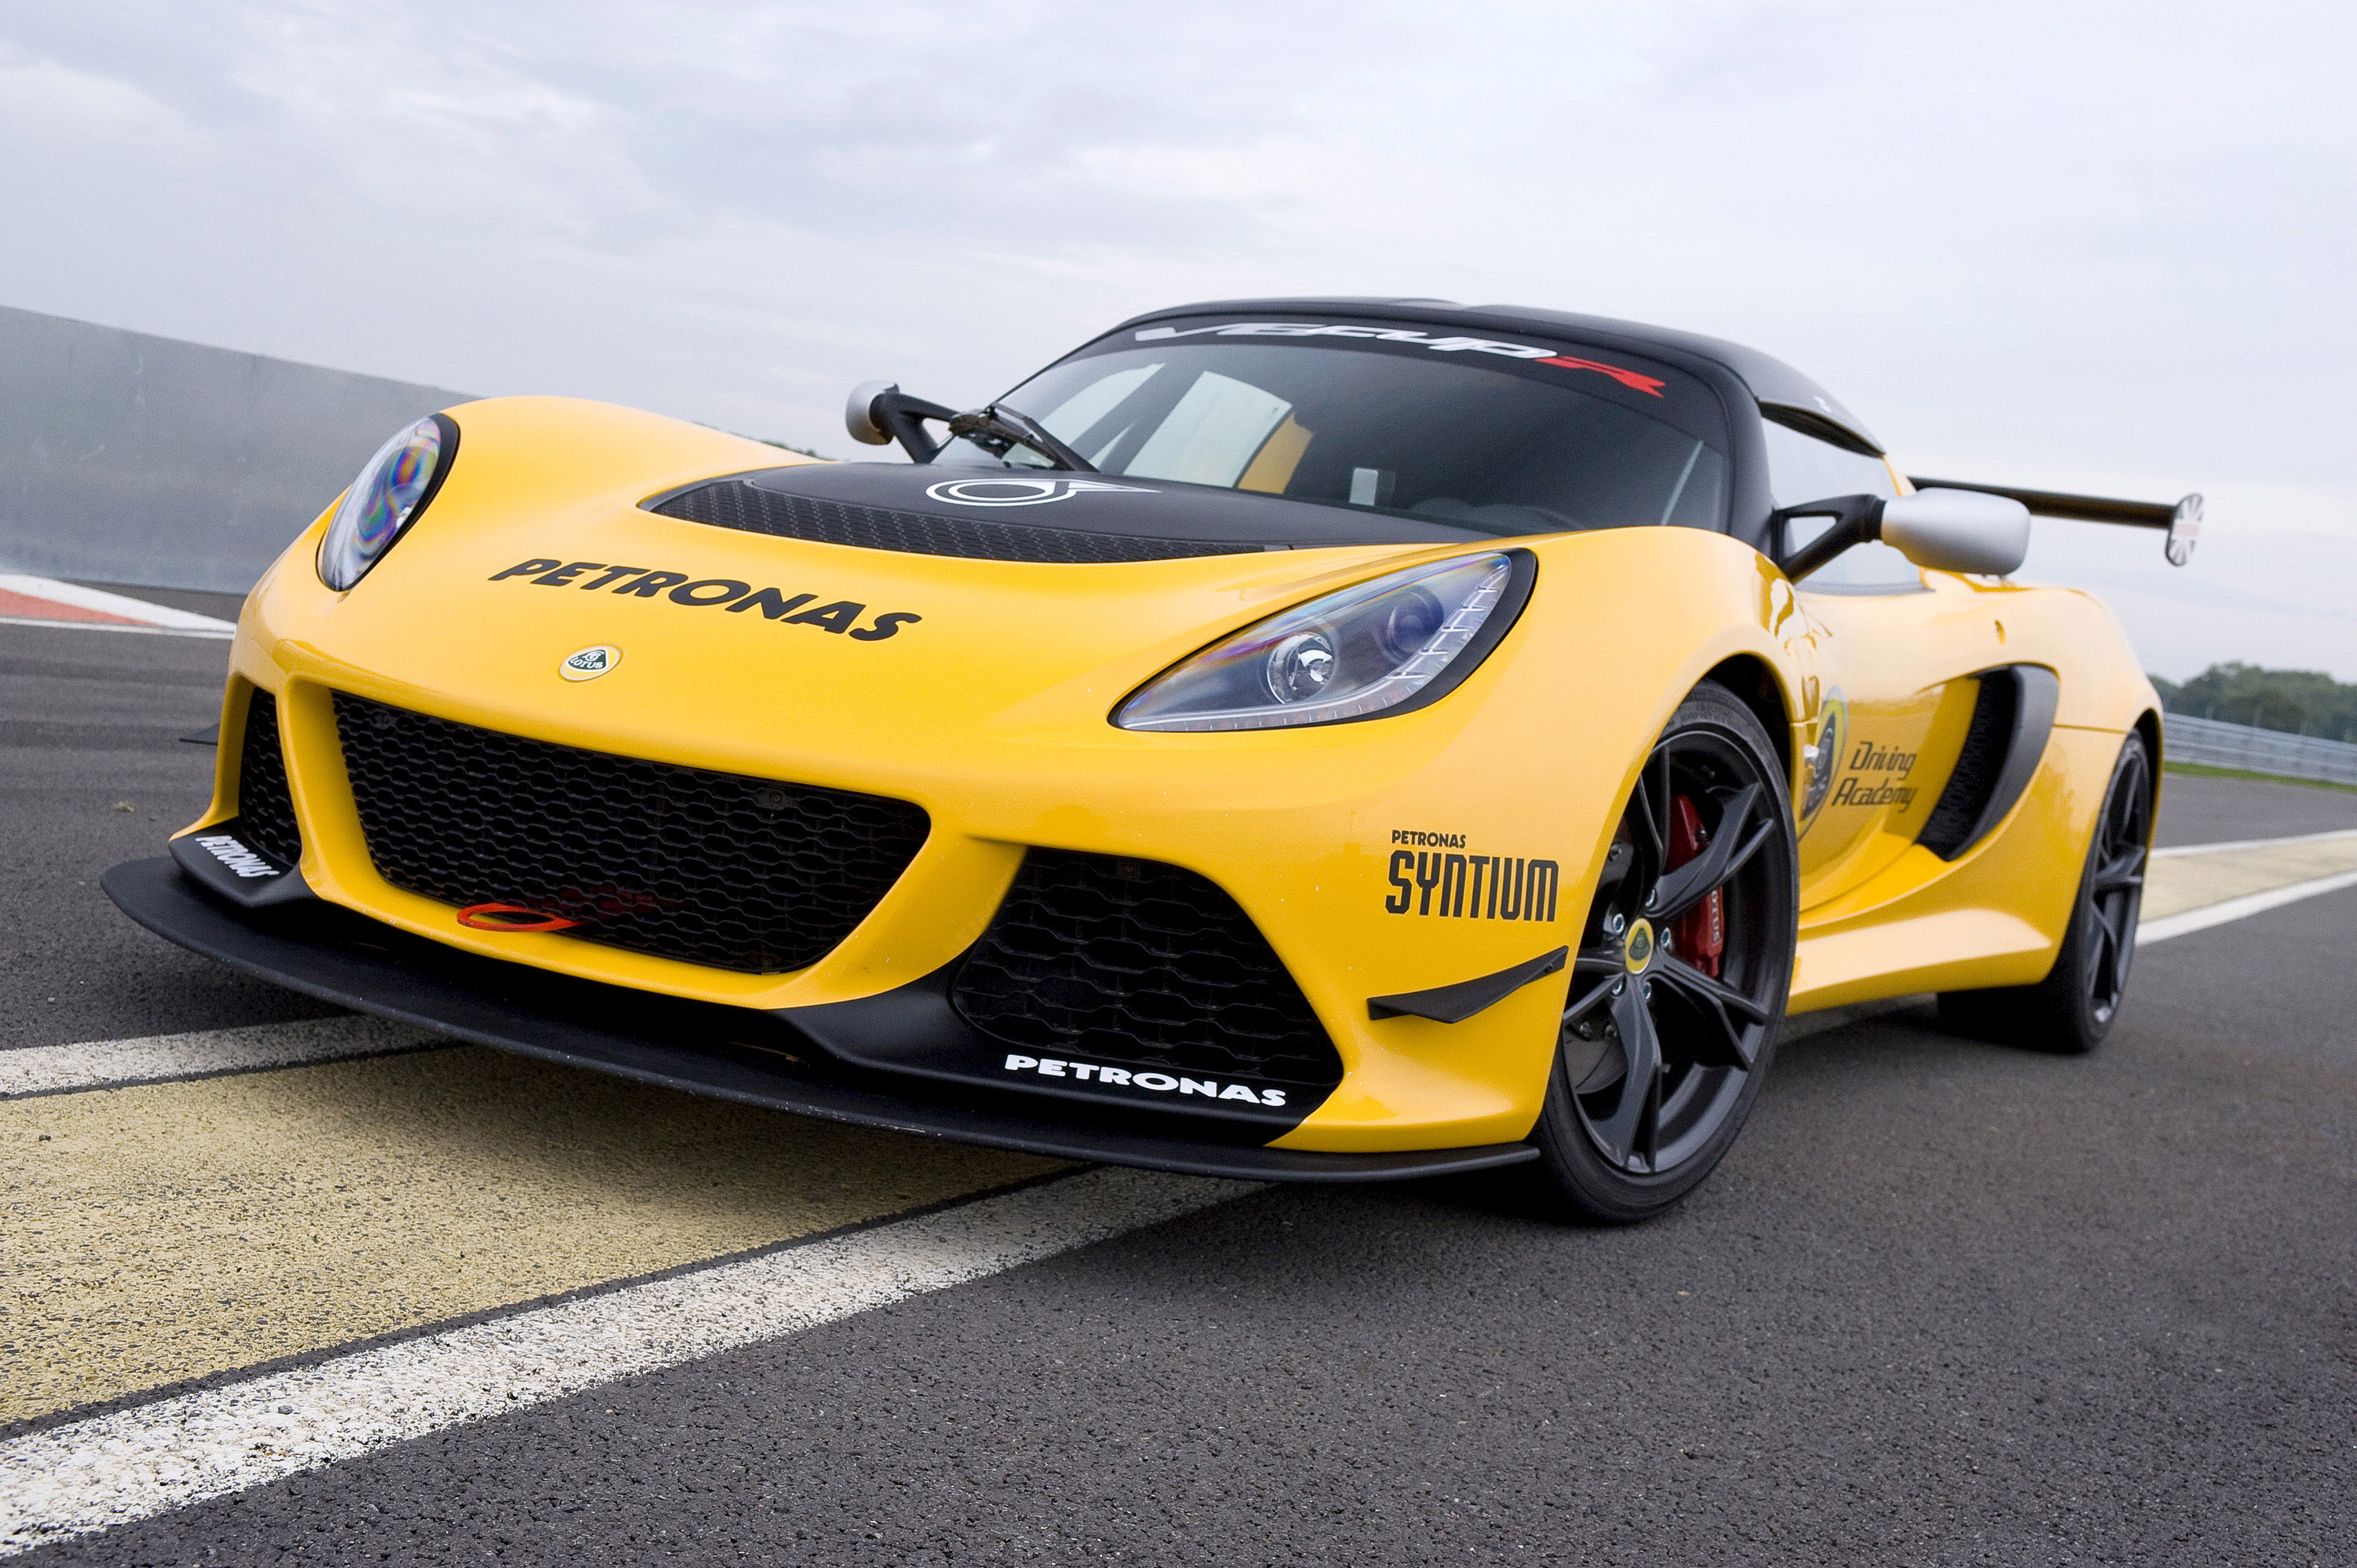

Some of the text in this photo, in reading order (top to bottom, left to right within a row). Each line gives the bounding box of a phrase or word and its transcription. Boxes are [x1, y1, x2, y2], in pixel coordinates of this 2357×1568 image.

[488, 559, 922, 641] PETRONAS
[570, 657, 603, 669] LOTUS
[1849, 741, 1917, 781] Driving
[1831, 777, 1918, 814] Academy
[1391, 830, 1466, 848] PETRONAS
[1385, 850, 1559, 921] SYNTIUM
[1711, 890, 1720, 942] OTUS
[1005, 1054, 1286, 1106] PETRONAS
